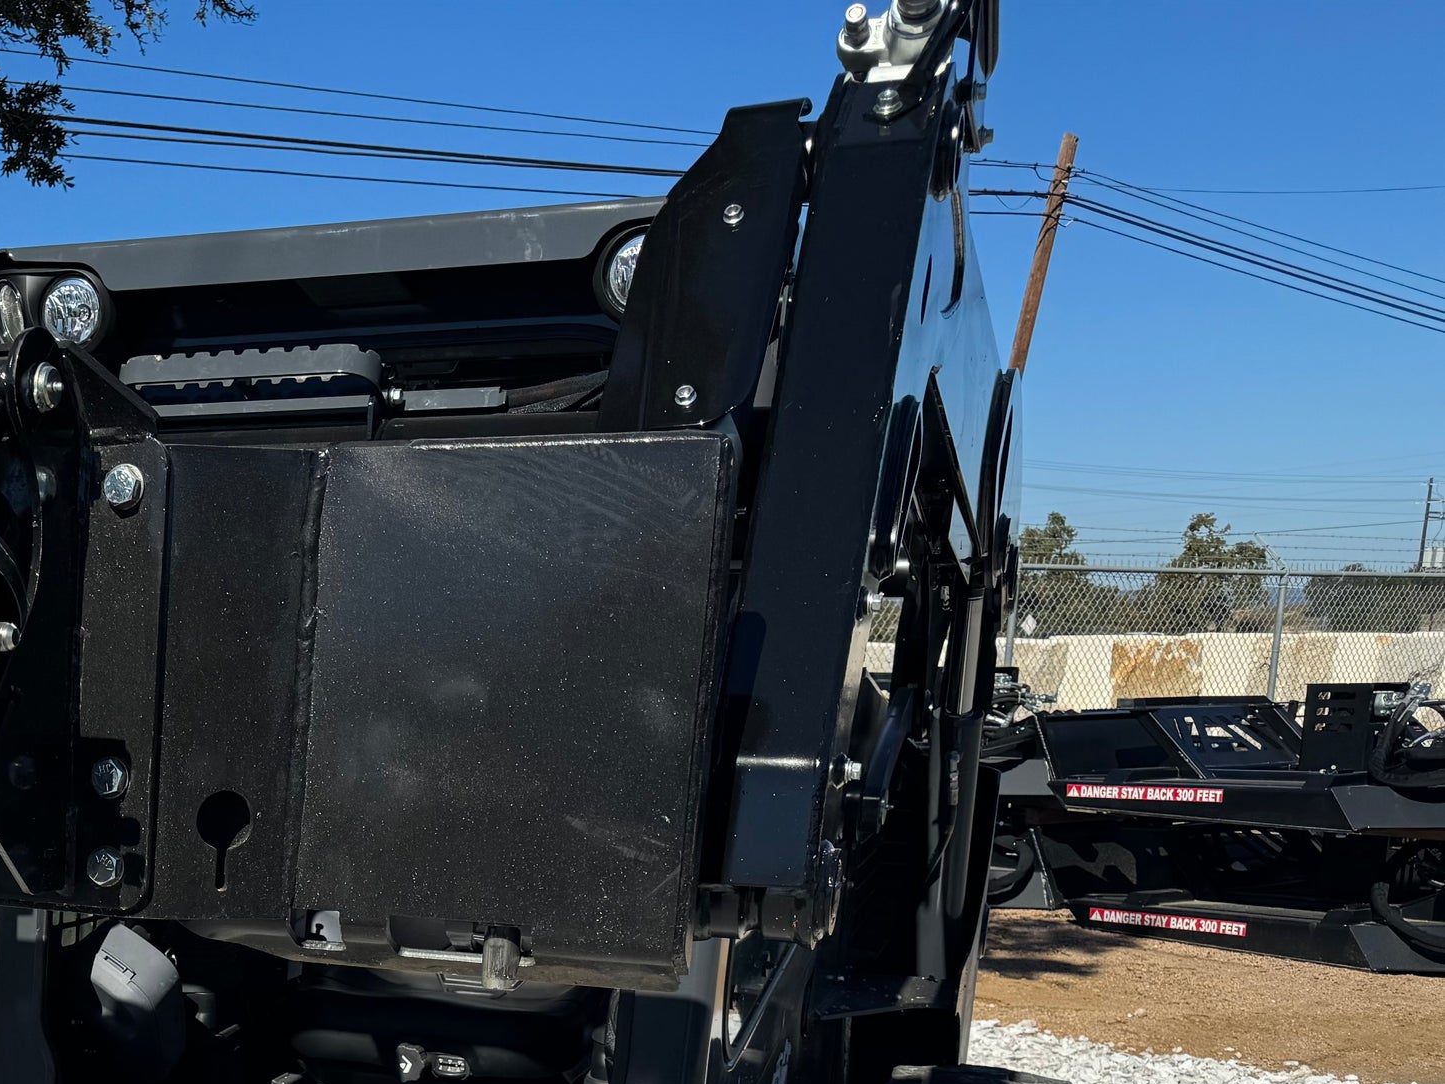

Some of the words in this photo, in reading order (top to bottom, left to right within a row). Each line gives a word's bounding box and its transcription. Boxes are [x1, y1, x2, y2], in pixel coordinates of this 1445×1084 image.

[1080, 785, 1119, 799] DANGER
[1120, 786, 1145, 800] STAY
[1147, 788, 1175, 801] BACK
[1176, 789, 1195, 802] 300
[1196, 790, 1223, 803] FEET
[1103, 910, 1141, 926] DANGER
[1143, 914, 1168, 928] STAY
[1169, 917, 1197, 931] BACK
[1199, 919, 1217, 934] 300
[1219, 922, 1246, 937] FEET
